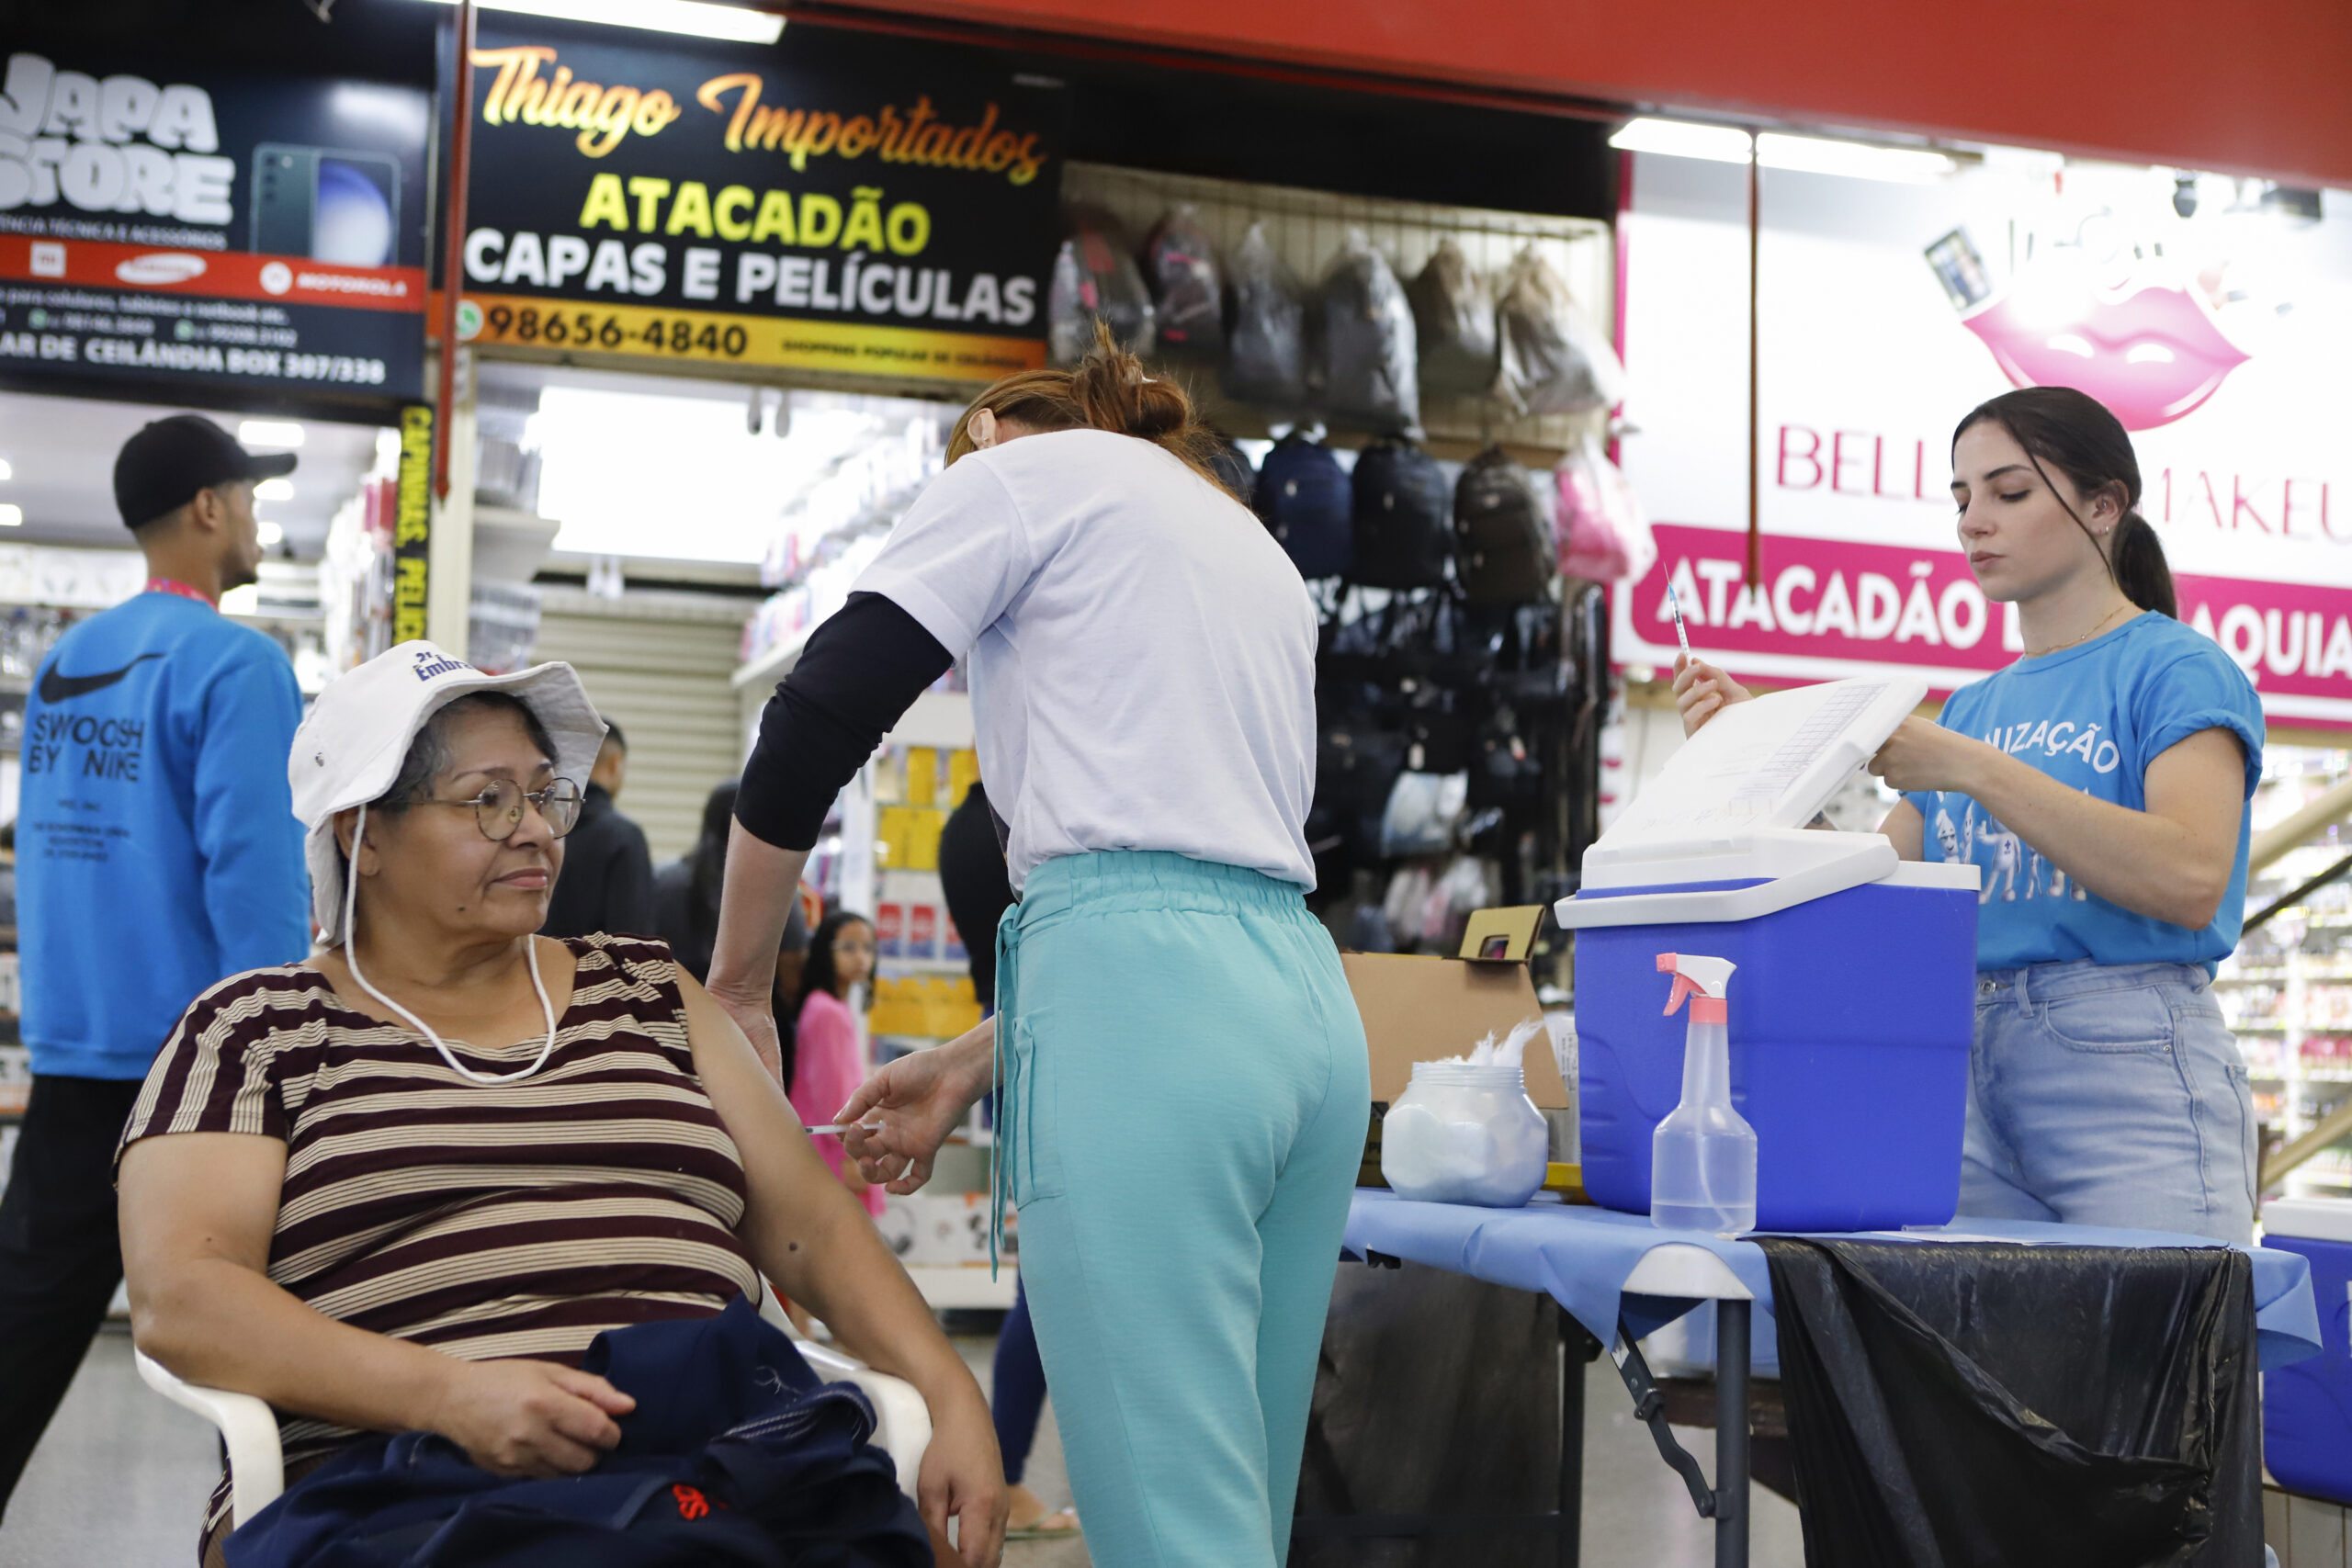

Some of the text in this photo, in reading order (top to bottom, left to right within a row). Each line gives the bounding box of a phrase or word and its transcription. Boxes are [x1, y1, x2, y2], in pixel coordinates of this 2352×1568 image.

[0, 52, 219, 152] JAPA
[469, 46, 1047, 186] Thiago Importados
[579, 172, 931, 256] ATACADÃO
[297, 271, 407, 298] MOTOROLA
[463, 227, 1036, 326] CAPAS E PELÍCULAS
[40, 333, 78, 361] DE
[85, 337, 224, 373] CEILÂNDIA
[227, 347, 281, 378] BOX
[488, 304, 748, 356] 98656-4840
[1777, 424, 1954, 504] BELL
[1656, 553, 1989, 650] ATACADÃO
[2190, 601, 2352, 687] AQUIA
[84, 749, 141, 783] NIKE
[1984, 719, 2120, 774] NIZAÇÃO
